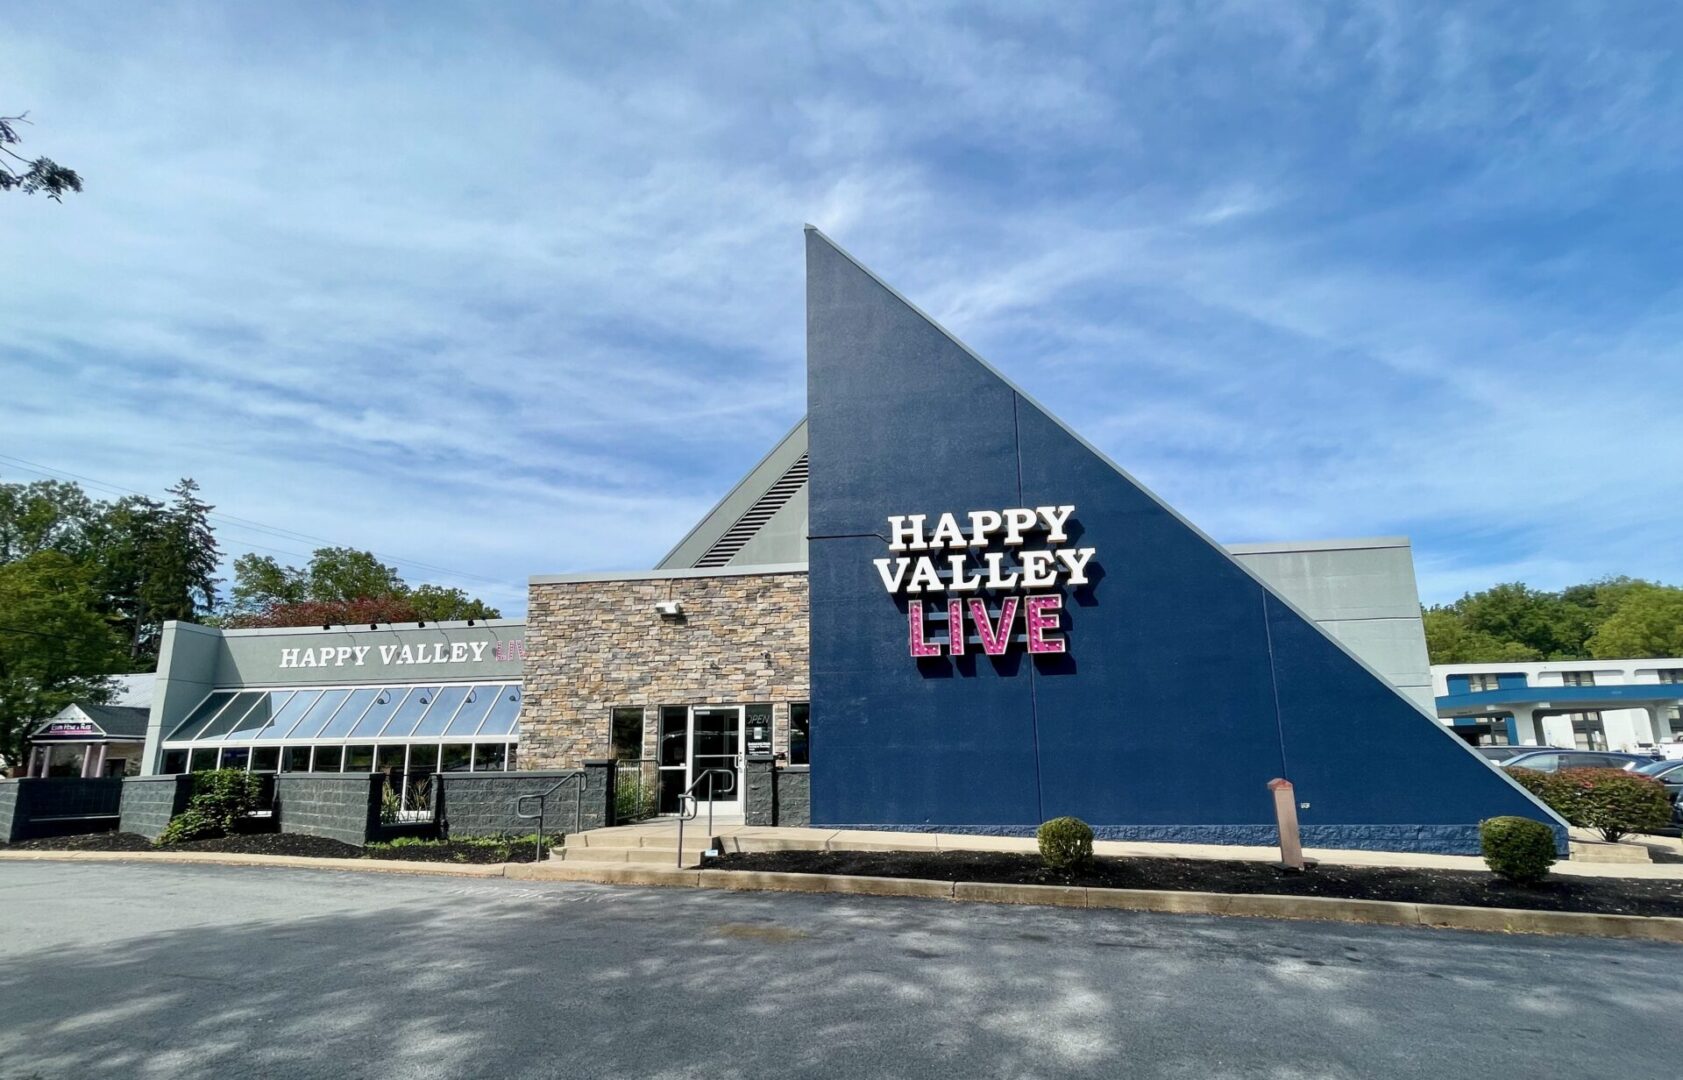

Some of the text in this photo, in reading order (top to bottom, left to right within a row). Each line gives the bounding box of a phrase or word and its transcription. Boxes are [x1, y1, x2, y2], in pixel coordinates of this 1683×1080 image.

[887, 505, 1075, 550] HAPPY
[873, 548, 1095, 593] VALLEY
[908, 594, 1066, 657] LIVE
[279, 645, 370, 668] HAPPY
[379, 641, 489, 665] VALLEY
